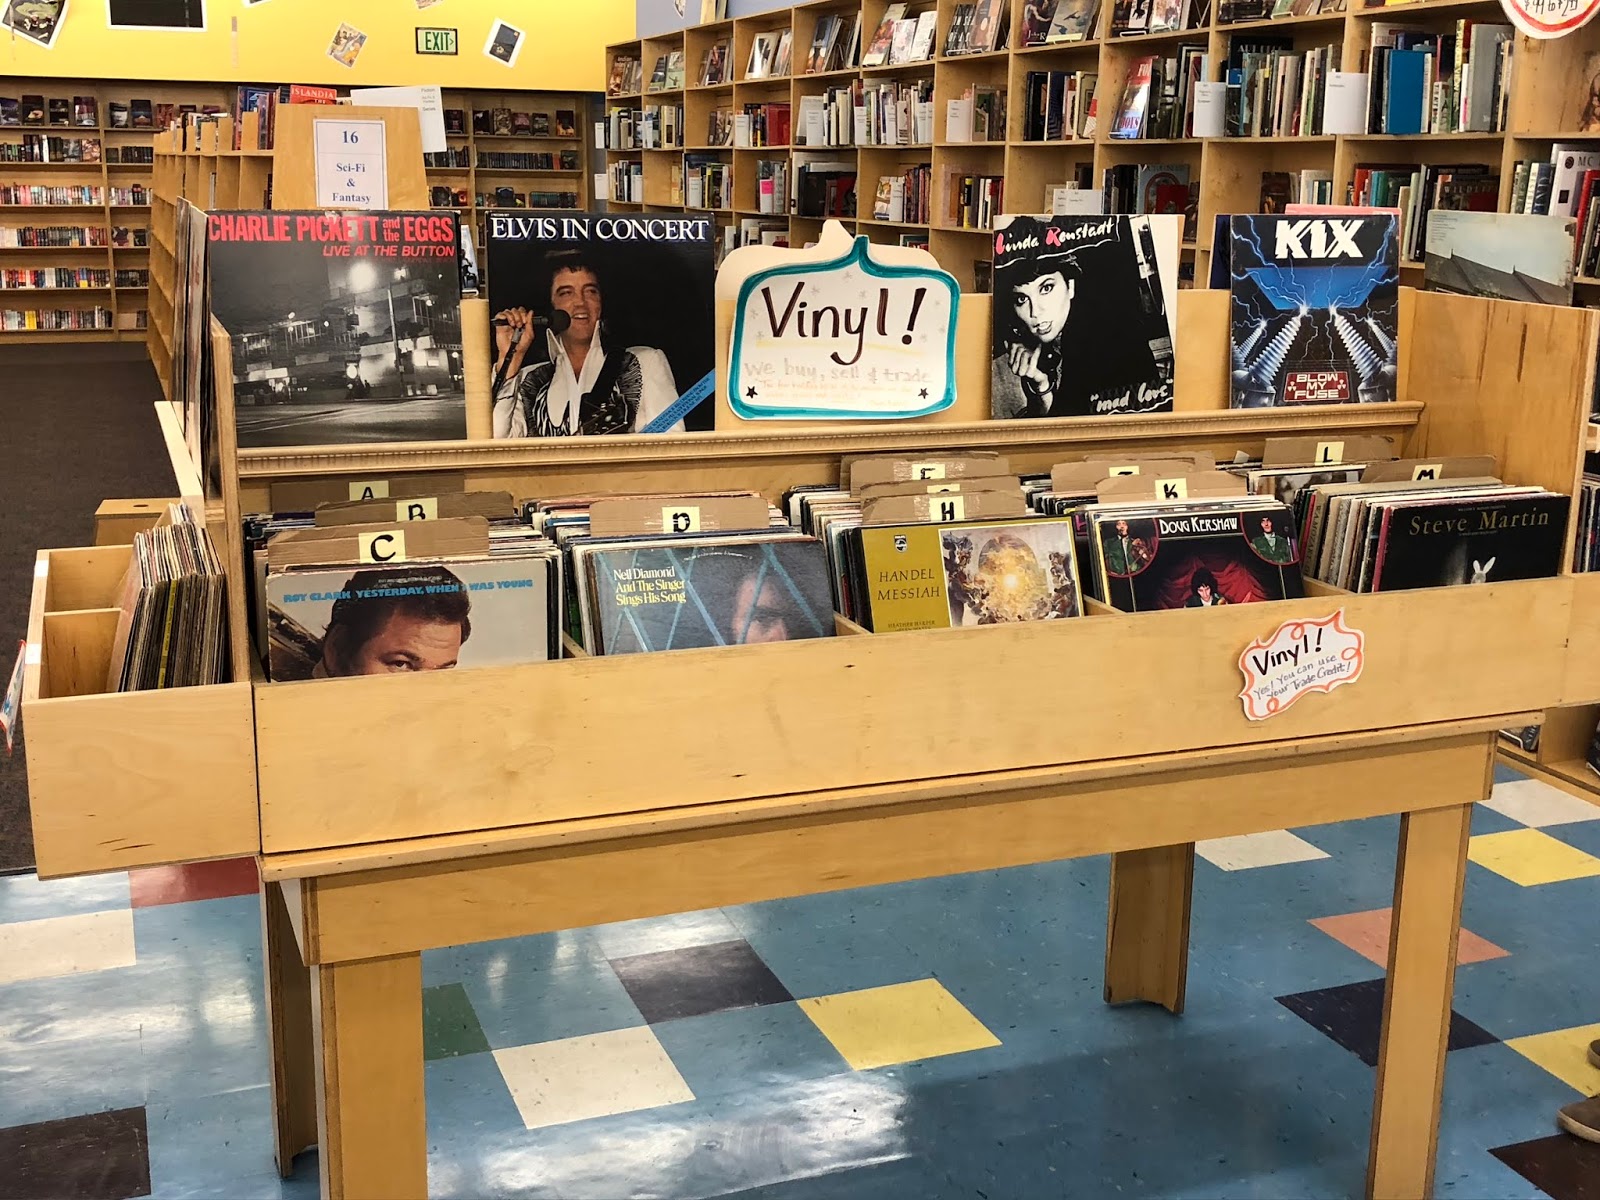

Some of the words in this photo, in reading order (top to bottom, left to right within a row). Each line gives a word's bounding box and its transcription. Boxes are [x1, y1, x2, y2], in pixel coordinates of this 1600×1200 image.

[425, 31, 450, 51] EXIT
[291, 87, 334, 99] ISLANDIA
[342, 130, 359, 144] 16
[336, 162, 366, 173] Sci-Fi
[346, 178, 356, 188] &
[332, 192, 371, 204] Fantasy
[208, 215, 291, 242] CHARLIE
[296, 216, 379, 242] PICKETT
[383, 217, 400, 229] and
[403, 217, 454, 242] EGGS
[490, 217, 557, 240] ELVIS
[560, 218, 590, 240] IN
[596, 218, 709, 241] CONCERT
[383, 229, 400, 242] the
[995, 232, 1040, 255] Linda
[1045, 217, 1115, 247] Ronstadt
[1274, 219, 1365, 259] KIX
[323, 245, 351, 257] LIVE
[354, 245, 371, 257] AT
[373, 245, 399, 257] THE
[401, 245, 455, 257] BUTTON
[761, 281, 927, 366] Vinyl!
[831, 365, 860, 380] sell
[883, 367, 934, 384] trade
[1296, 373, 1339, 382] BLOW
[1294, 390, 1339, 399] FUSE
[1306, 382, 1327, 390] MY
[1322, 446, 1333, 463] L
[1416, 469, 1434, 480] M
[361, 487, 374, 500] A
[1163, 483, 1179, 499] K
[408, 503, 425, 520] B
[940, 501, 955, 521] H
[672, 512, 691, 532] D
[1159, 518, 1190, 534] DOUG
[1191, 517, 1237, 532] KERSHAW
[1409, 515, 1468, 536] Steve
[1478, 506, 1549, 530] Martin
[370, 534, 396, 561] C
[613, 568, 632, 581] Neil
[633, 566, 675, 580] Diamond
[879, 568, 935, 582] HANDEL
[283, 593, 308, 603] ROY
[309, 591, 351, 602] CLARK
[356, 586, 424, 599] YESTERDAY,
[425, 583, 460, 594] WHEN
[469, 581, 495, 591] WAS
[497, 579, 534, 589] YOUNG
[615, 581, 636, 593] And
[635, 580, 655, 591] The
[655, 579, 686, 592] Singer
[877, 586, 941, 601] MESSIAH
[616, 594, 643, 607] Sings
[643, 593, 660, 604] His
[661, 591, 687, 604] Song
[1252, 627, 1323, 676] Vinyl!
[1253, 680, 1274, 700] Yes!
[1297, 662, 1314, 675] can
[1318, 654, 1338, 666] use
[1291, 673, 1316, 690] Trade
[1317, 661, 1351, 679] Credit!
